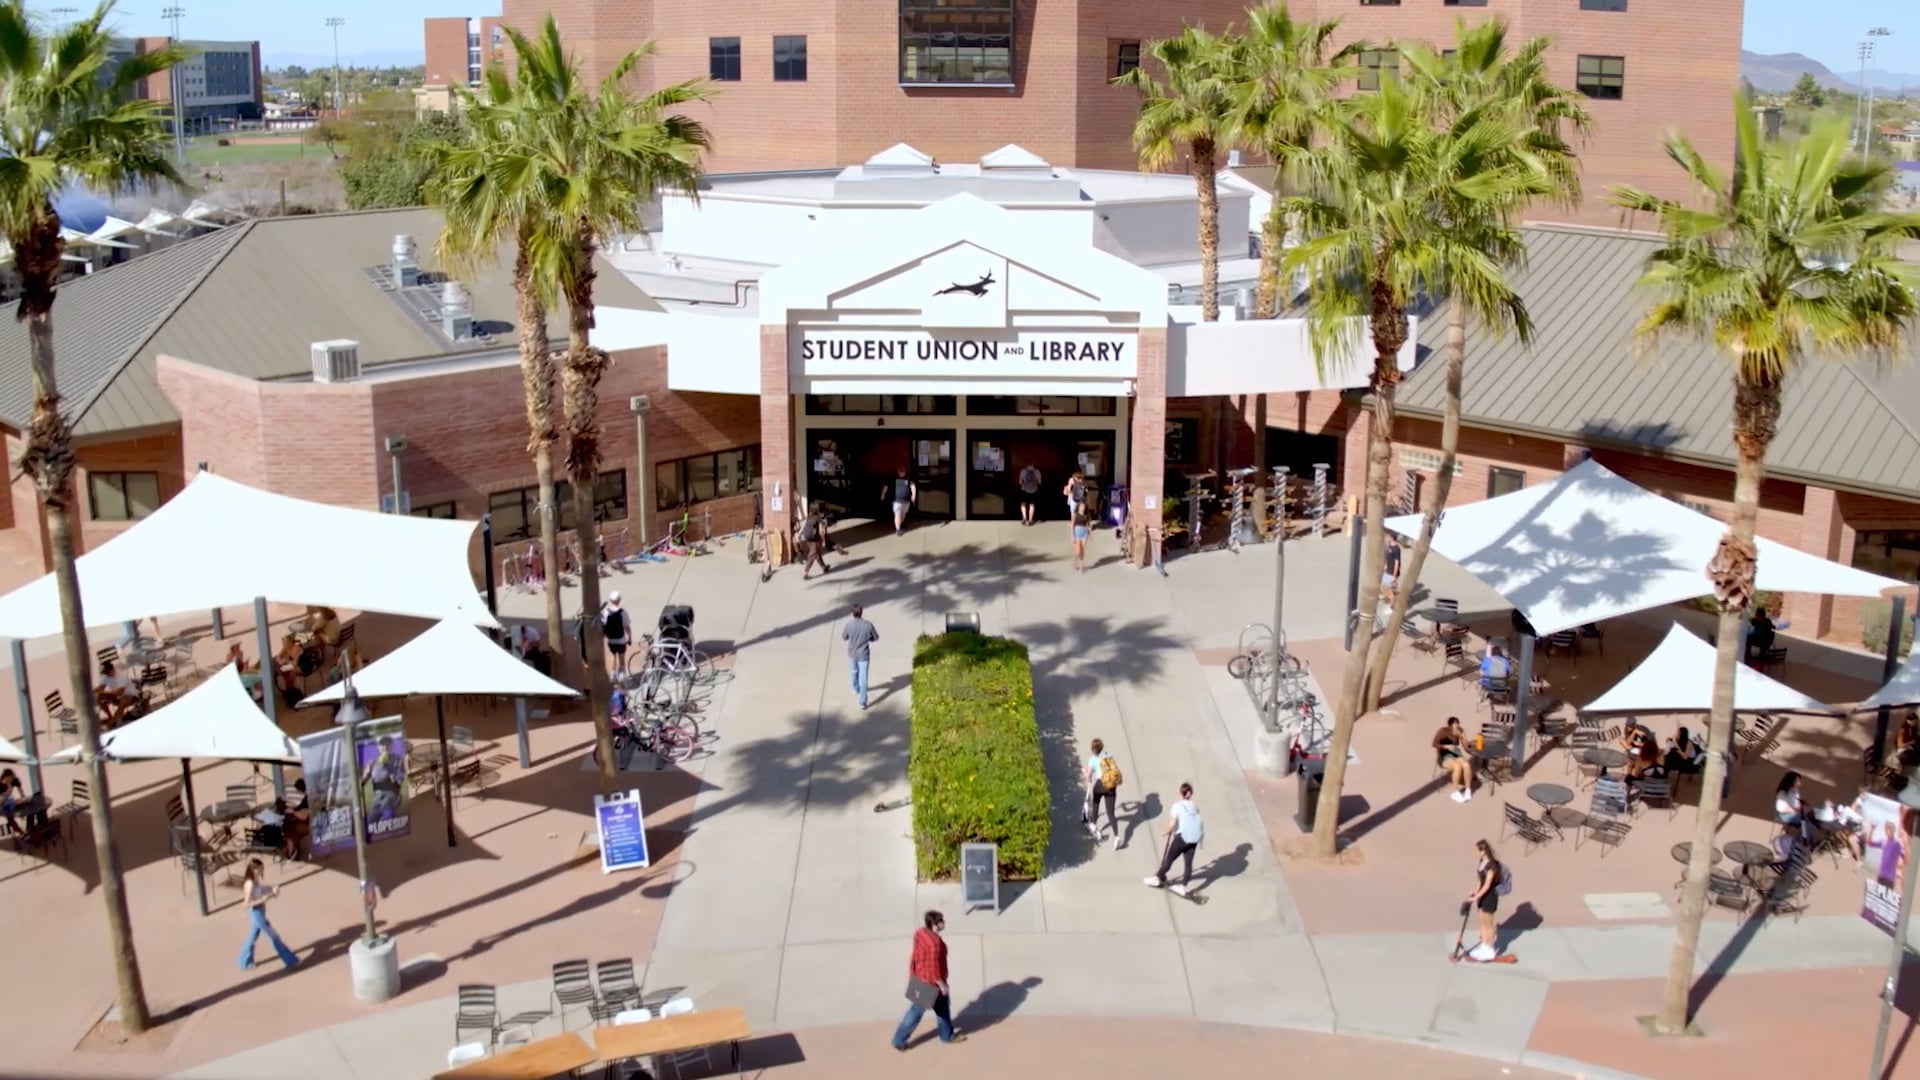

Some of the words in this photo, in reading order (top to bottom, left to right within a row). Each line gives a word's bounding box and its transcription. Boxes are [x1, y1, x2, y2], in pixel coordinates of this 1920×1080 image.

[802, 339, 909, 360] STUDENT
[917, 340, 998, 360] UNION
[1004, 347, 1024, 355] AND
[1030, 341, 1125, 361] LIBRARY
